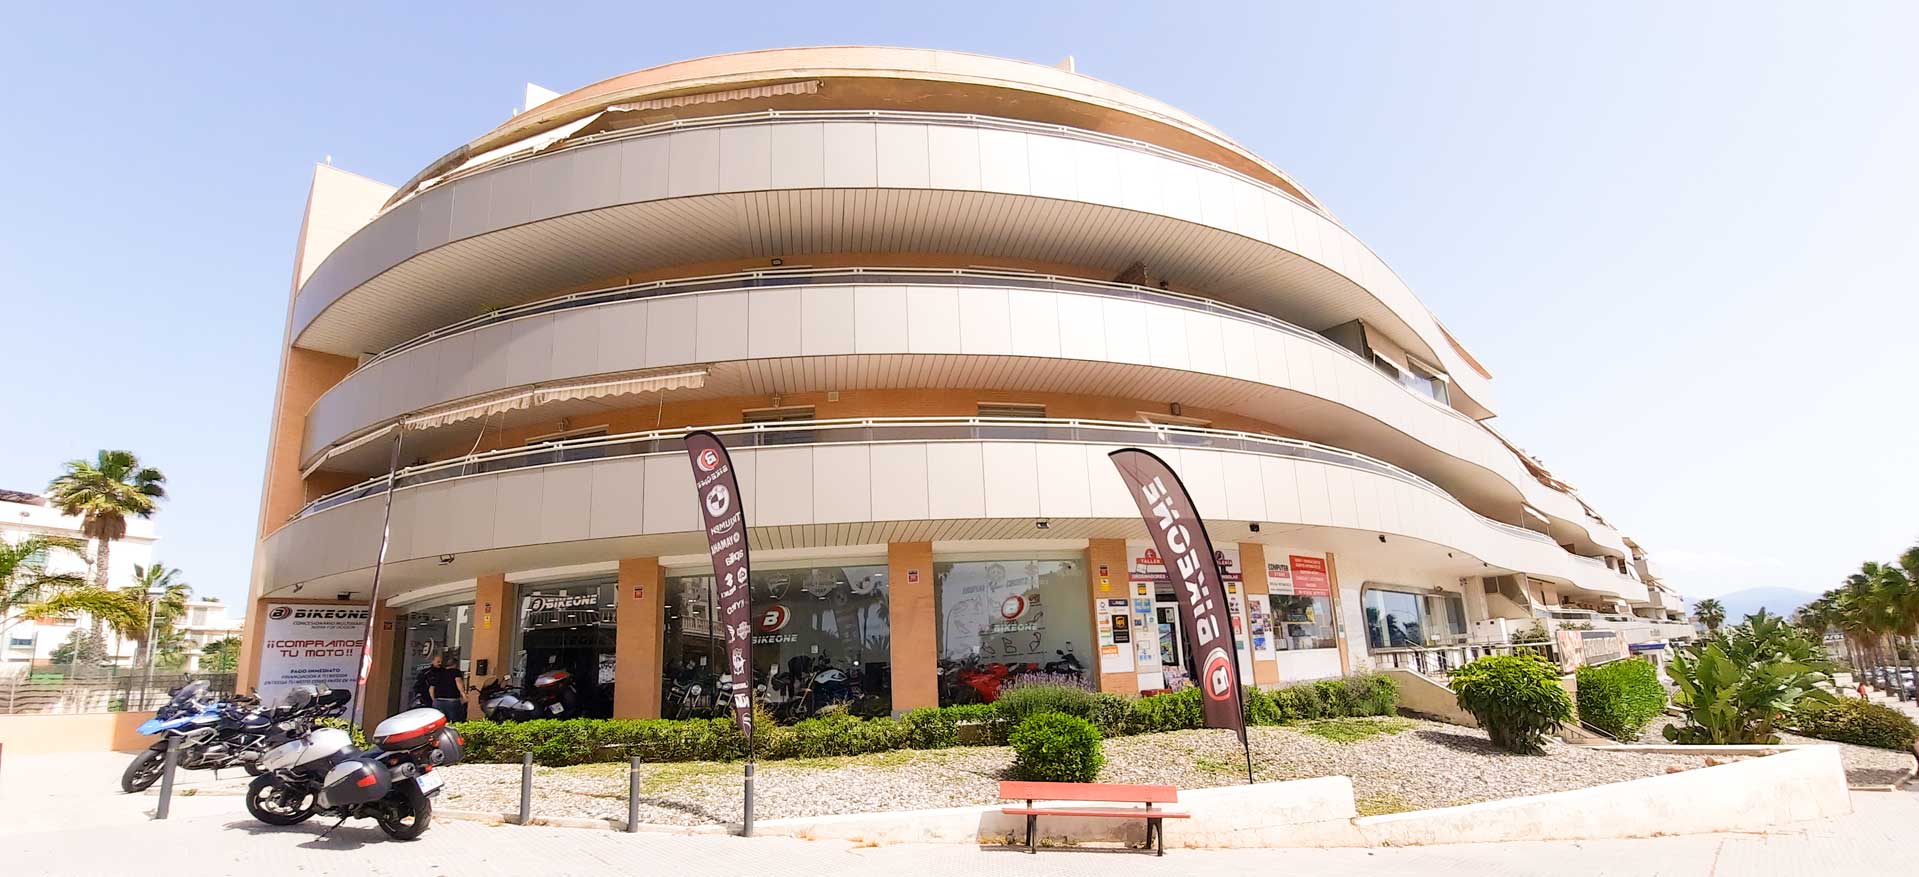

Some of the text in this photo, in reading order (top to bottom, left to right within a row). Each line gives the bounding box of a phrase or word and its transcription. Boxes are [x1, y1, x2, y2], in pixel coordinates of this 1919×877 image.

[545, 594, 598, 609] BIKEONE
[294, 609, 368, 619] BIKEONE
[994, 623, 1038, 632] BIKEONE
[280, 648, 353, 657] TU MOTO!!
